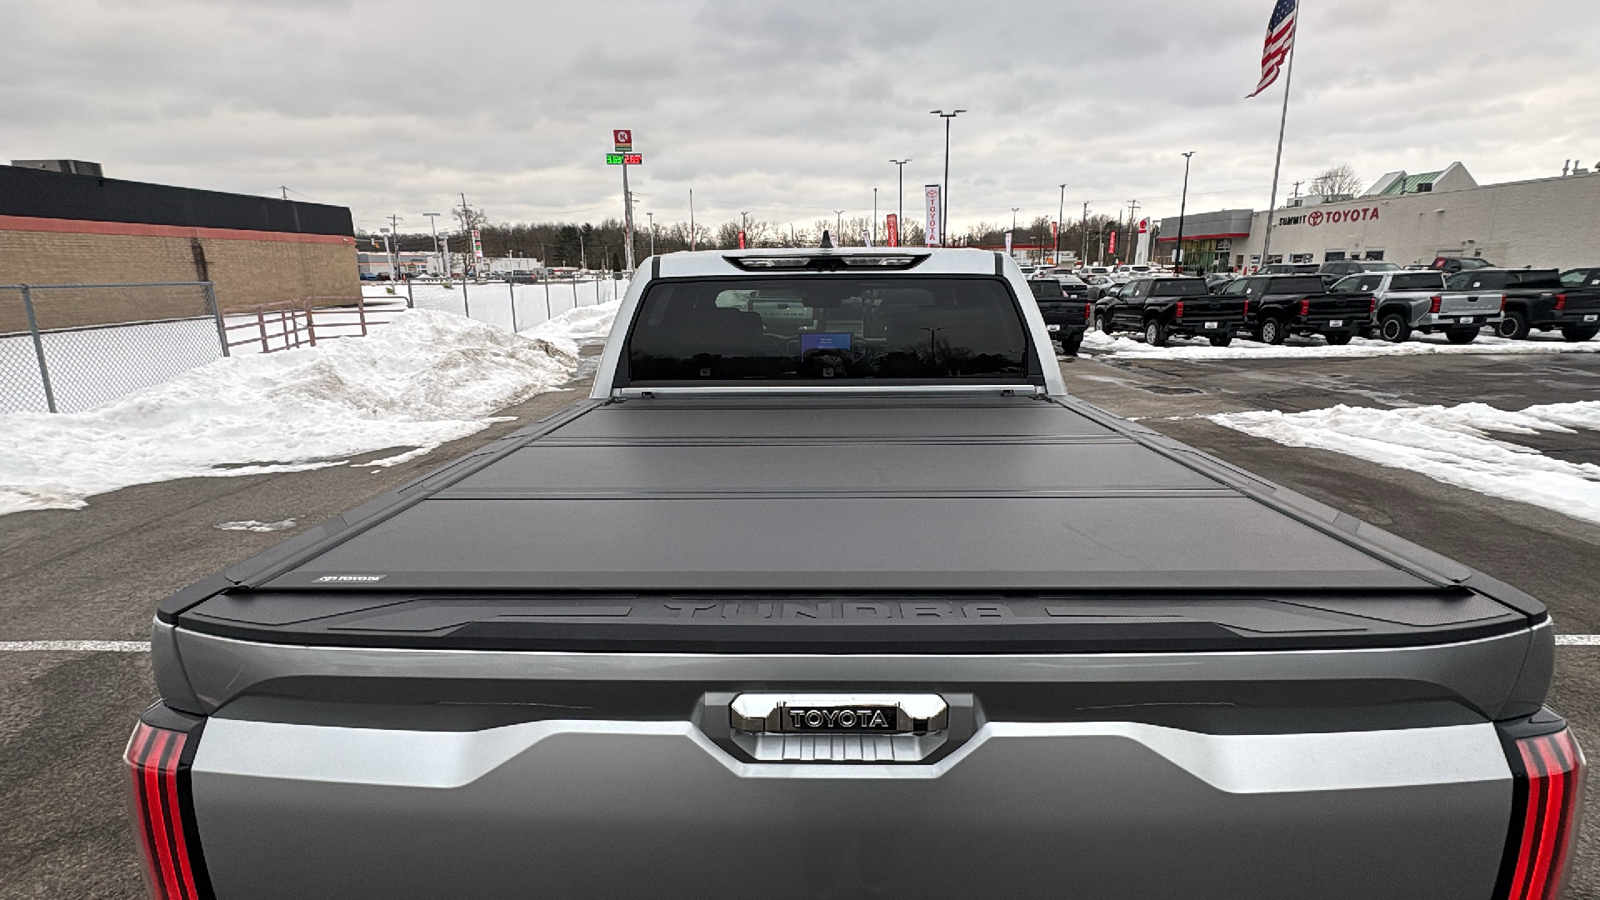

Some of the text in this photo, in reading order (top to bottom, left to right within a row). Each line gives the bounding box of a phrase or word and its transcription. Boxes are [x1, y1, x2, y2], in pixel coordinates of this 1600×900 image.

[1278, 207, 1379, 226] SUMMIT TOYOTA
[663, 602, 1014, 619] TUNDRA
[790, 710, 888, 727] TOYOTA
